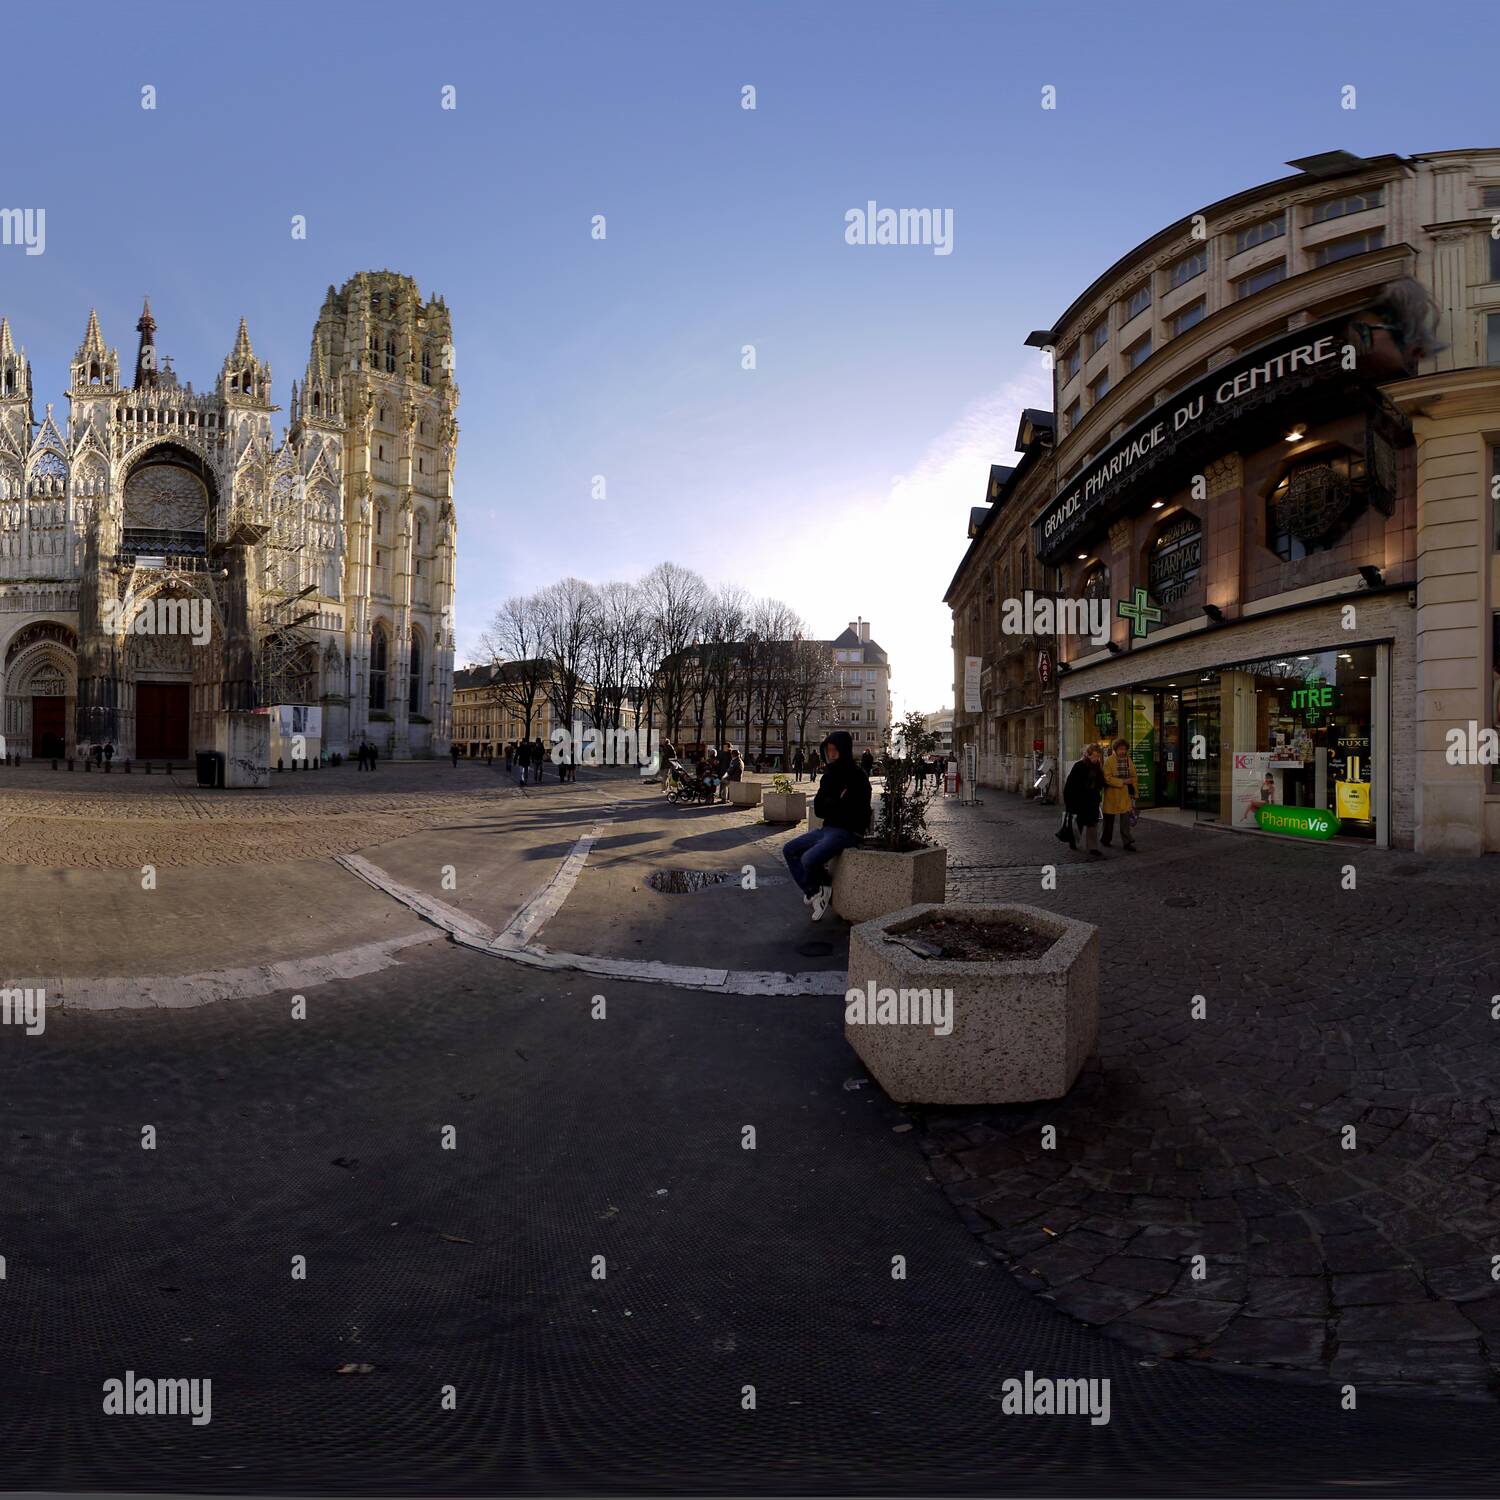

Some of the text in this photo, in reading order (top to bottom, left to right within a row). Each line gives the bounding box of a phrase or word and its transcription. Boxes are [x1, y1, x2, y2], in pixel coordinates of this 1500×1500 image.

[1044, 336, 1336, 536] GRANDE PHARMACIE DU CENTRE
[1261, 812, 1329, 833] PharmaVie
